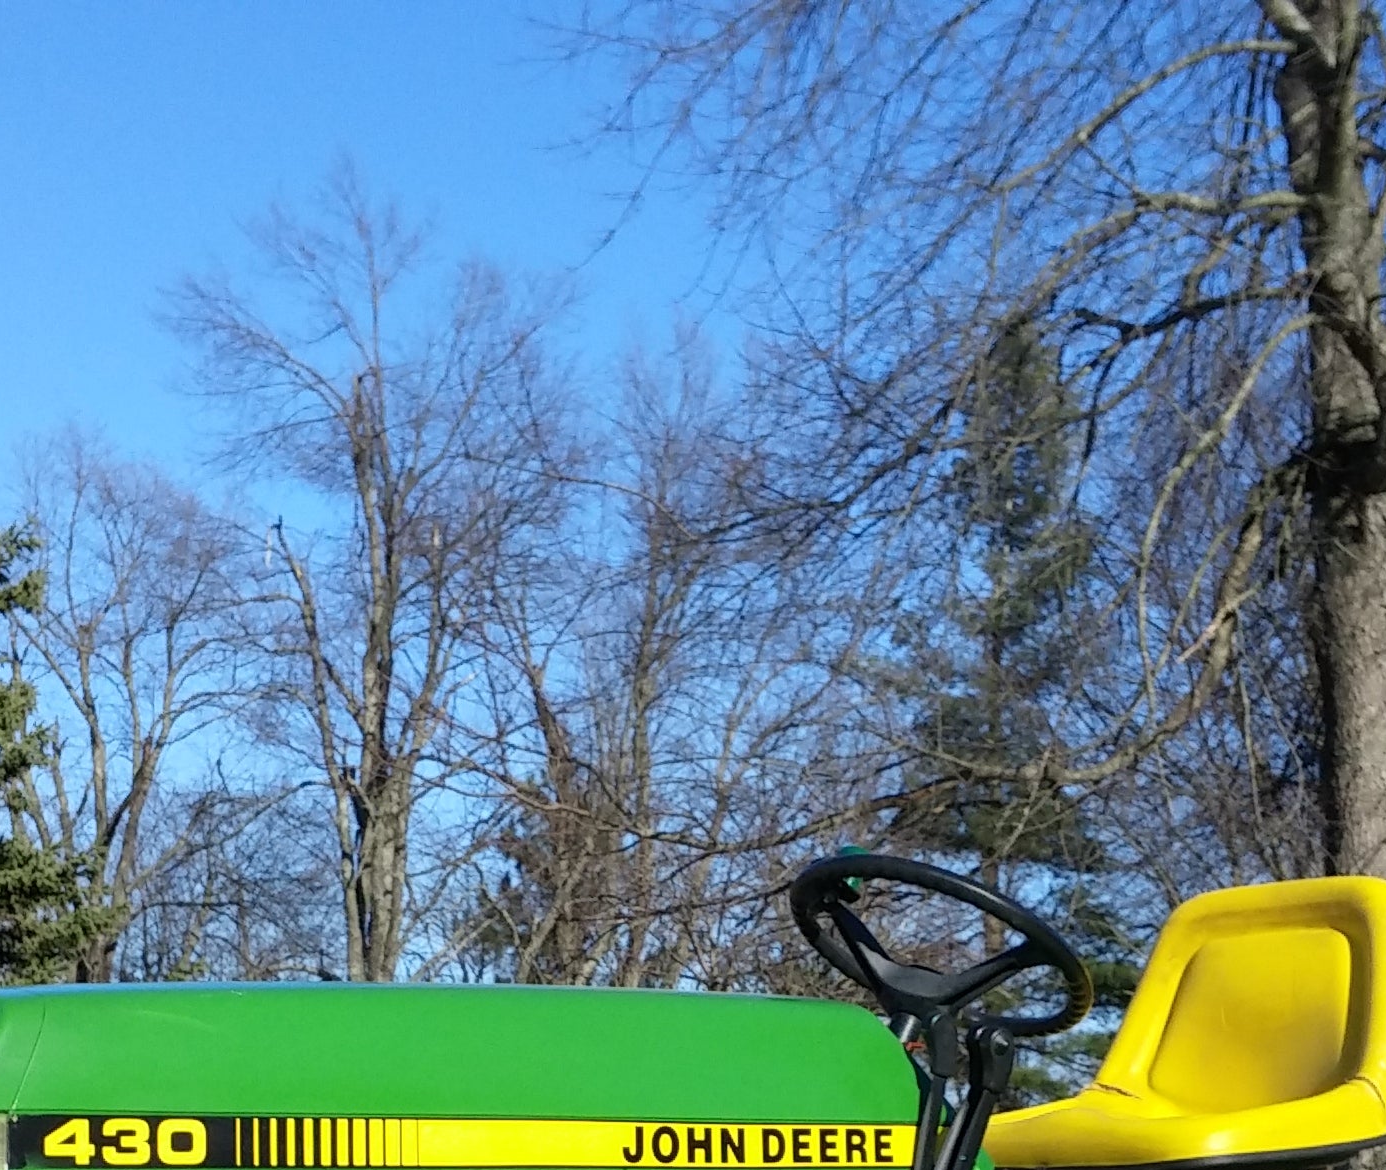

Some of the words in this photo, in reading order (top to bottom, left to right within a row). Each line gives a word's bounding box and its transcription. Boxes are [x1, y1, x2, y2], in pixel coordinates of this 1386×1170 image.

[44, 1118, 207, 1165] 430
[623, 1126, 745, 1163] JOHN
[762, 1128, 893, 1163] DEERE
